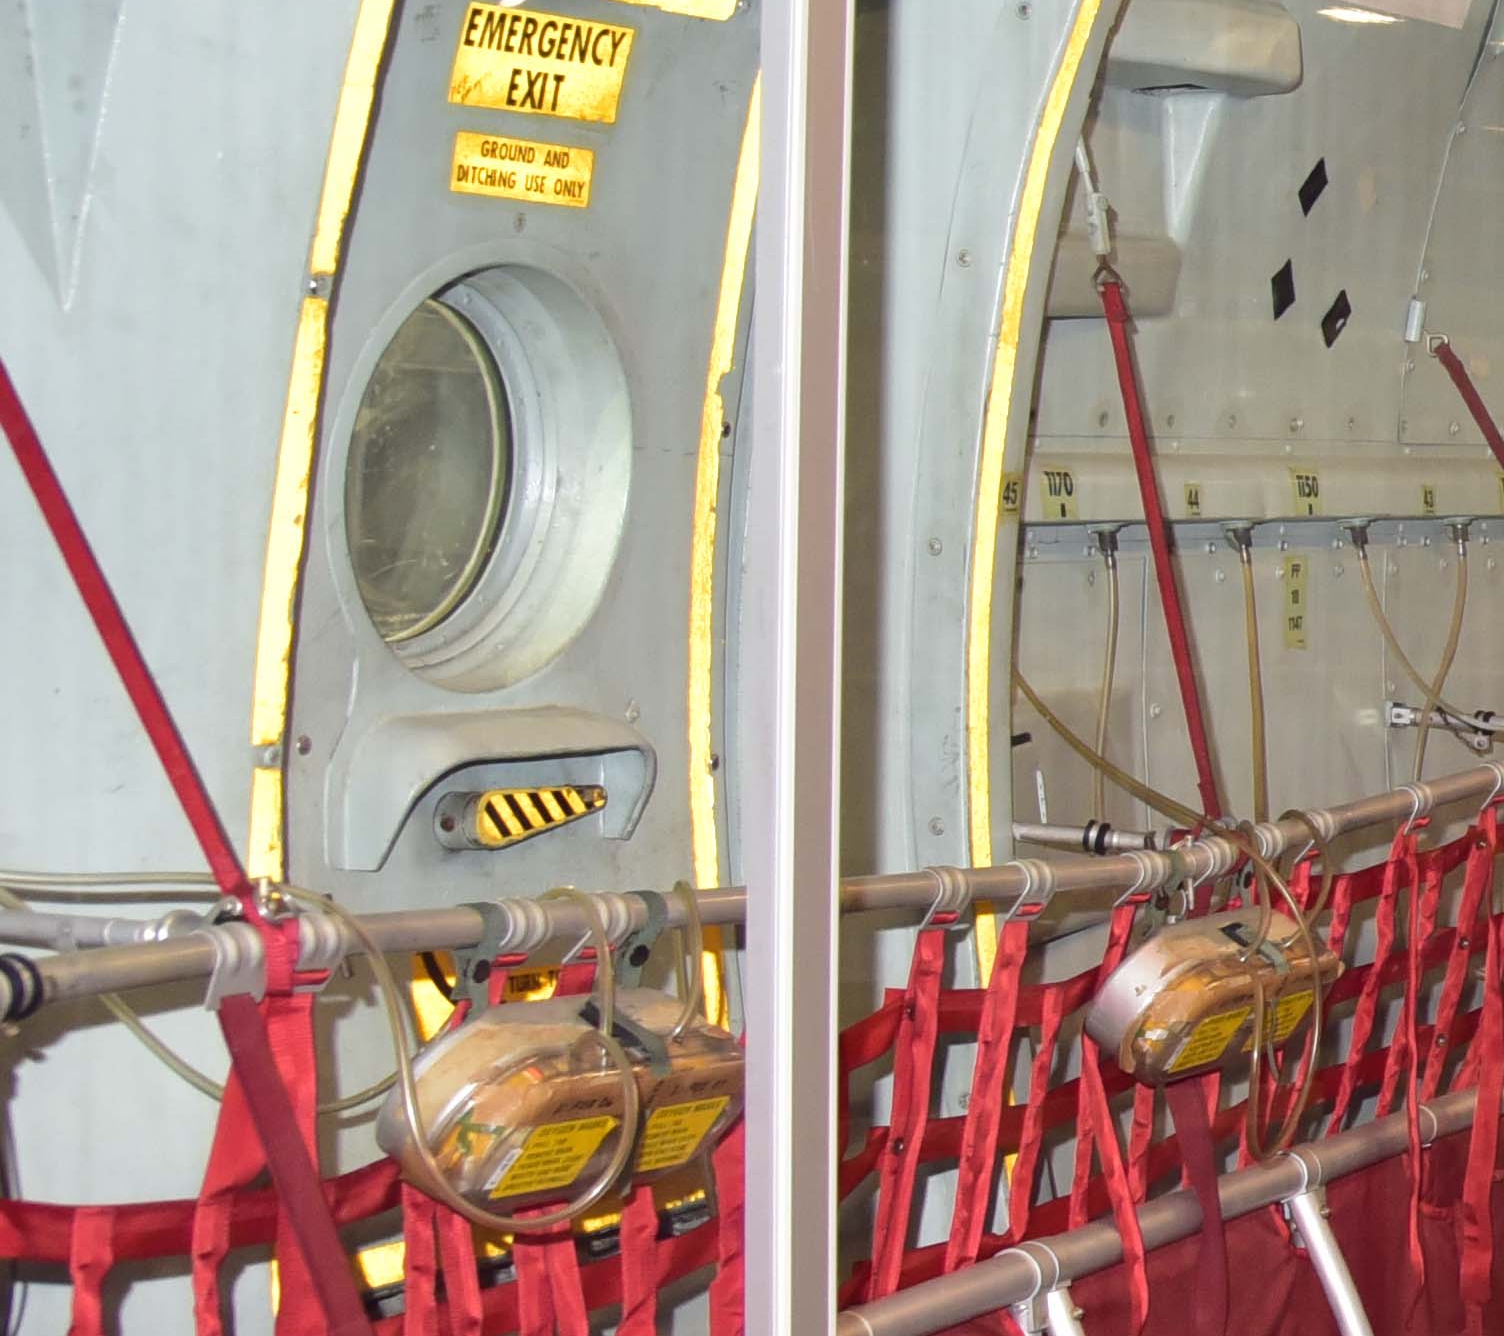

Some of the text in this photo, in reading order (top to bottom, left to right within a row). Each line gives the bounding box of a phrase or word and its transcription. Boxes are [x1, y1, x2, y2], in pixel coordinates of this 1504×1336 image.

[464, 8, 626, 67] EMERGENCY
[506, 68, 565, 112] EXIT
[481, 140, 570, 169] GROUND AND
[456, 164, 586, 199] DITCHING USE ONLY
[1003, 481, 1018, 505] 45
[1043, 471, 1074, 497] 1170
[1295, 475, 1319, 499] 1150
[1187, 488, 1200, 510] 44
[1423, 490, 1435, 509] 43
